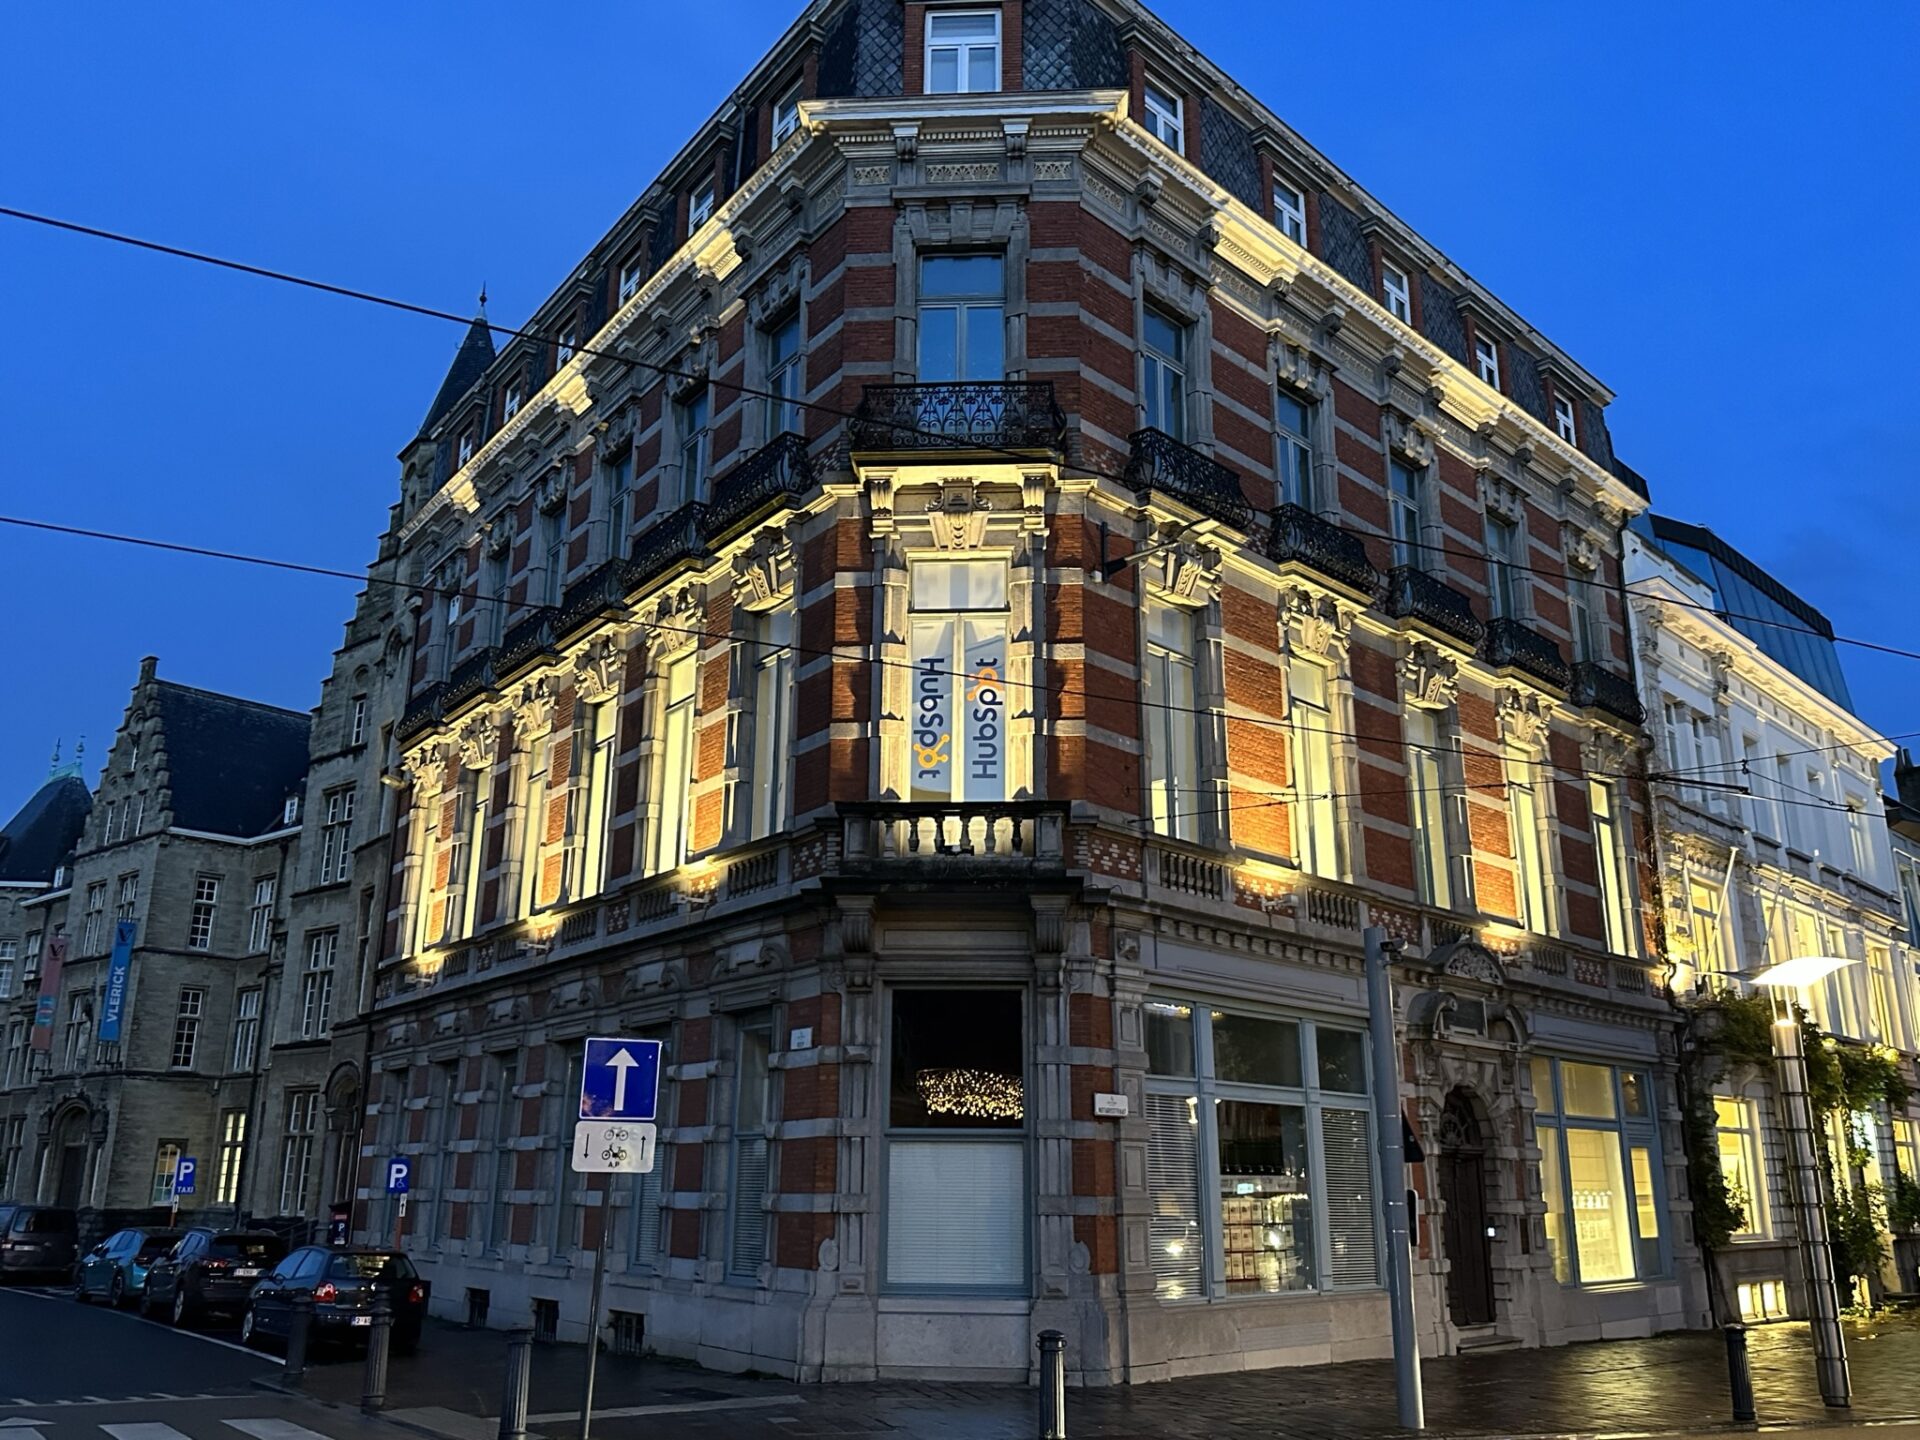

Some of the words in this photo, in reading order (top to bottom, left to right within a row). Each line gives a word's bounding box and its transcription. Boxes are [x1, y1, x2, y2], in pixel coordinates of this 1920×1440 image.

[914, 658, 949, 779] HubSpot
[967, 658, 1005, 779] HubSpot
[106, 966, 125, 1022] VLERICK
[177, 1186, 194, 1194] TAXI
[179, 1162, 194, 1181] P
[389, 1163, 408, 1188] P
